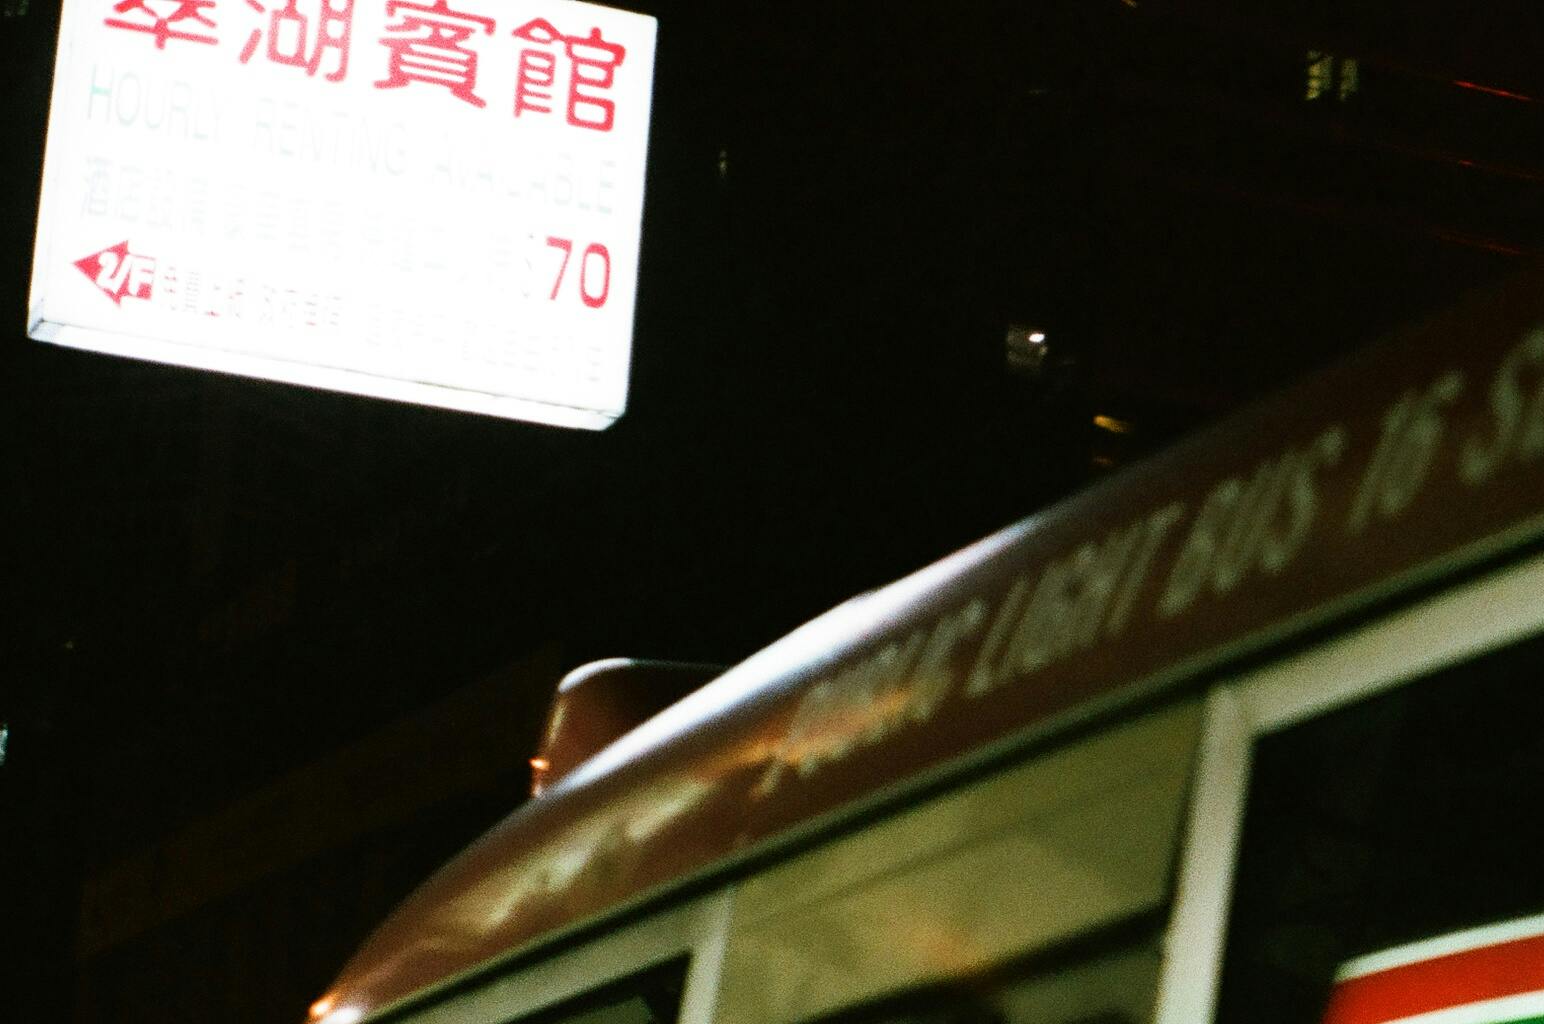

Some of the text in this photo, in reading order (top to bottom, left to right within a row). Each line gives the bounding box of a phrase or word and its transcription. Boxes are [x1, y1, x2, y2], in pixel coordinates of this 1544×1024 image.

[86, 62, 618, 216] HOURLY RENTING AVALABLE
[966, 502, 1184, 698] LIGHT
[1158, 425, 1346, 617] BUS
[1349, 369, 1464, 534] 16
